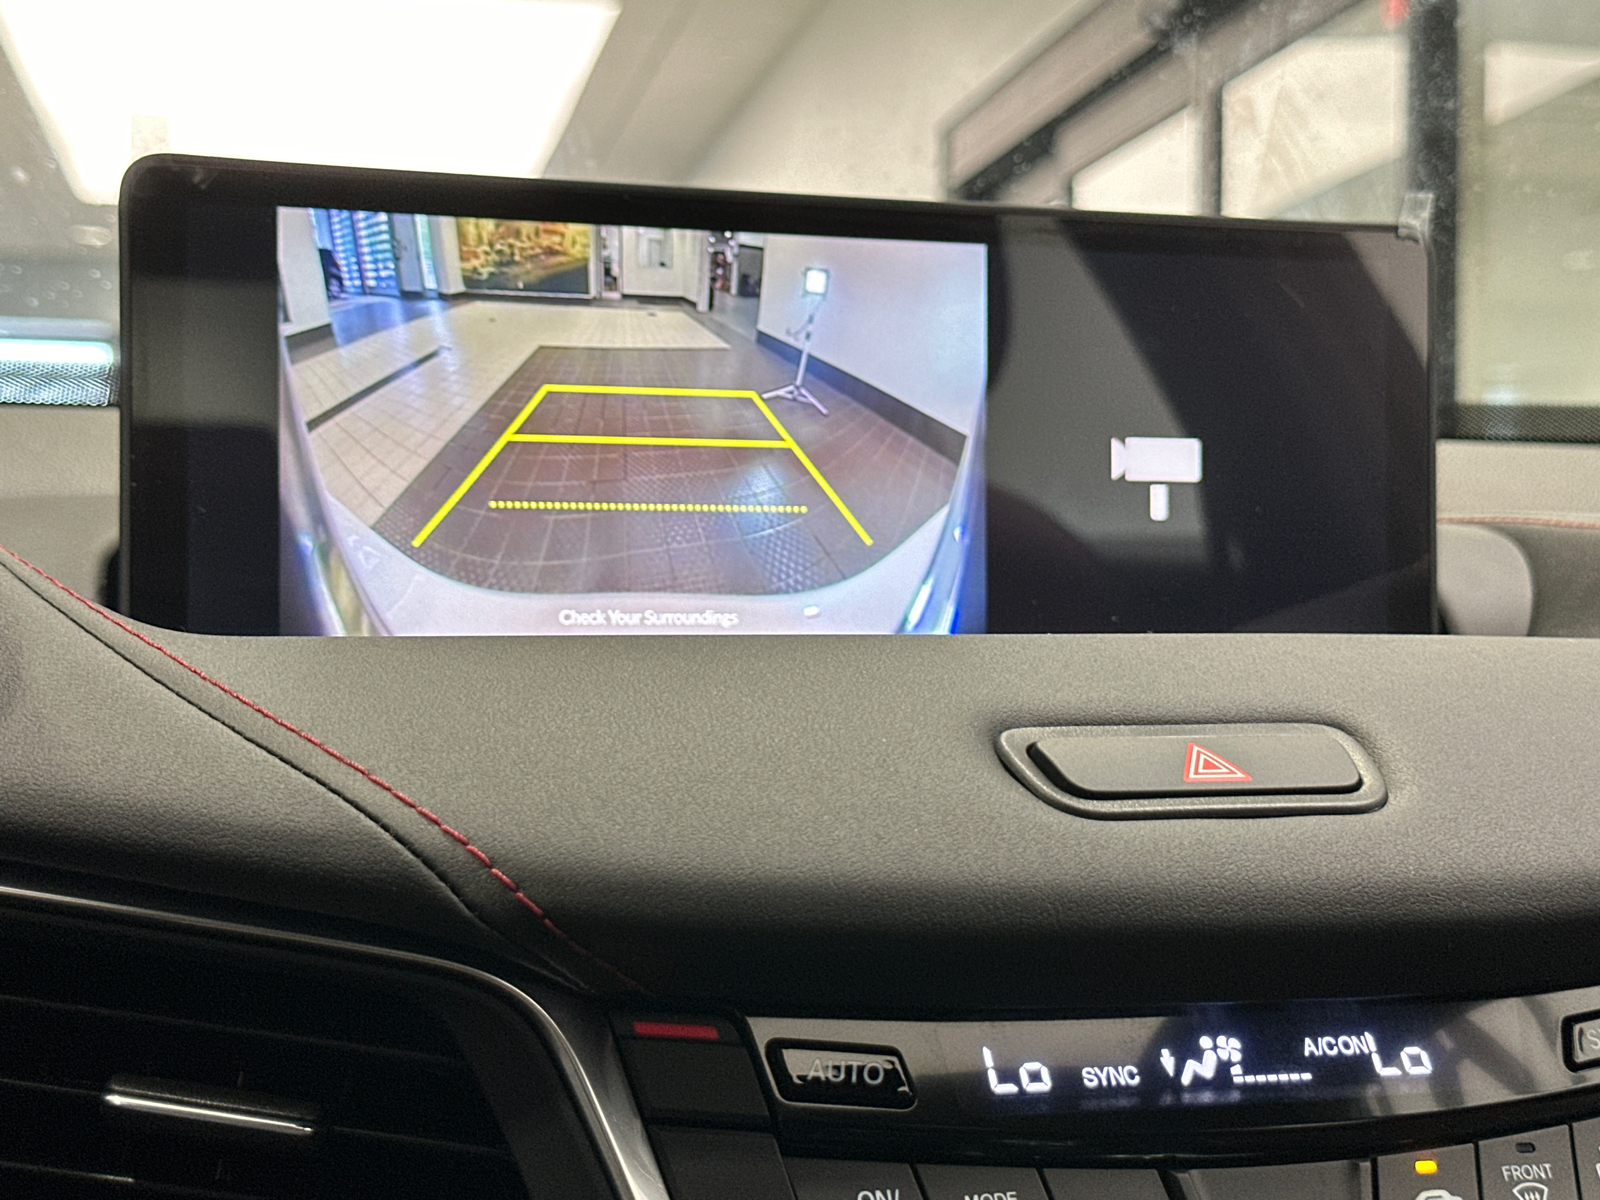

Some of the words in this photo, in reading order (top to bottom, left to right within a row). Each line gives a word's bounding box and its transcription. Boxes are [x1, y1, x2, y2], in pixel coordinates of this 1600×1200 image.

[558, 609, 606, 626] Check
[607, 609, 642, 626] Your
[643, 609, 740, 629] Surroundings
[1363, 1031, 1433, 1076] Lo
[806, 1058, 885, 1085] AUTO
[982, 1045, 1052, 1095] Lo
[1081, 1065, 1140, 1088] SYNC
[1501, 1163, 1553, 1181] FRONT
